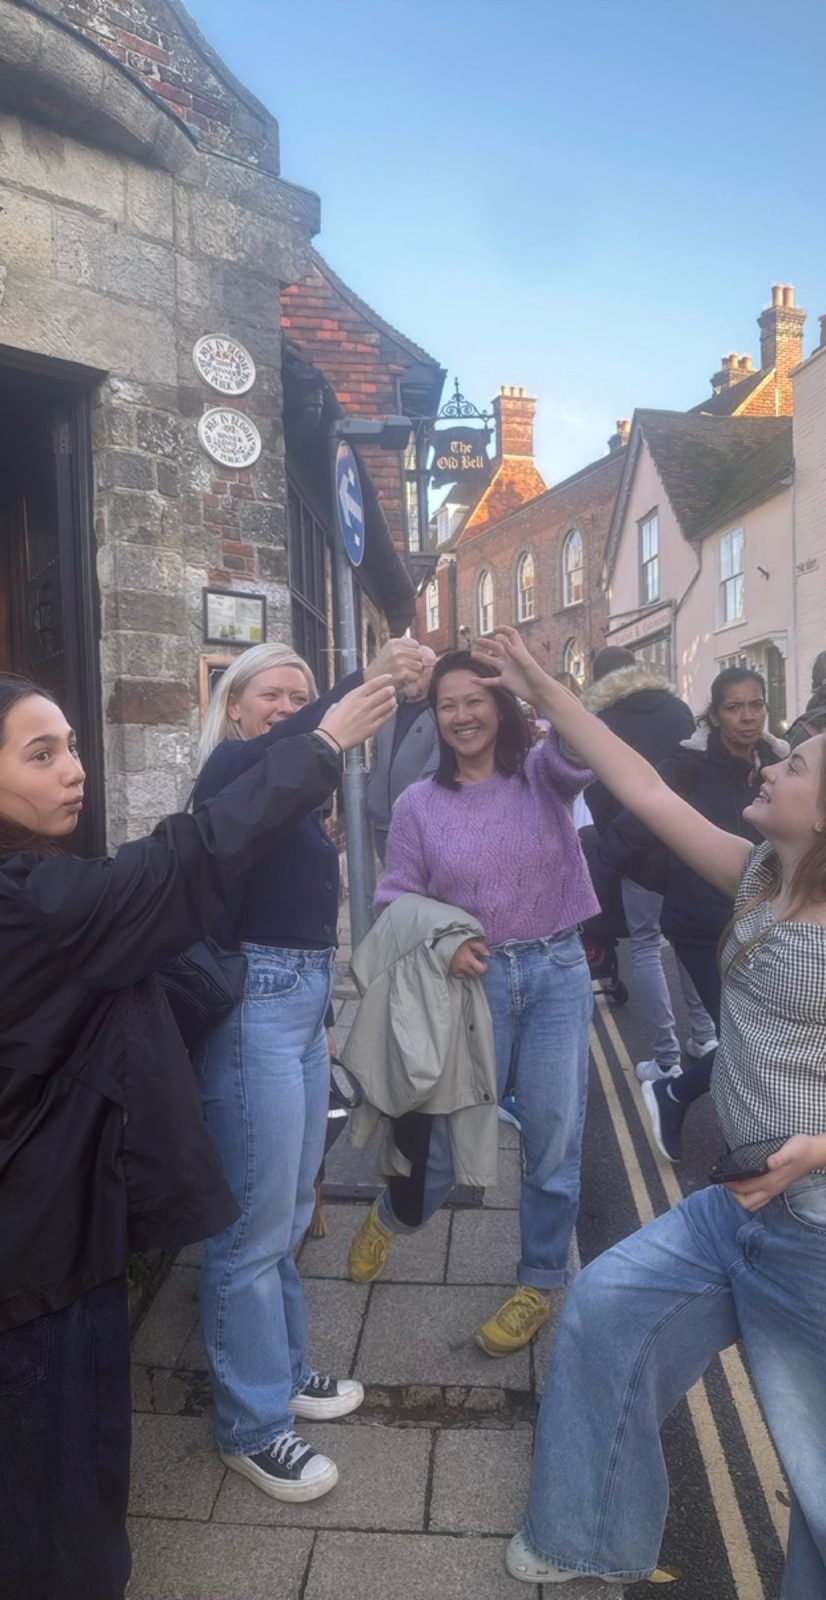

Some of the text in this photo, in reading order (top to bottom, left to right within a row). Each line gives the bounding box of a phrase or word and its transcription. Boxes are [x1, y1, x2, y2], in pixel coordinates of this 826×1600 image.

[215, 339, 225, 351] IN
[219, 413, 229, 425] IN
[450, 440, 473, 454] The
[436, 455, 484, 470] Old Bell
